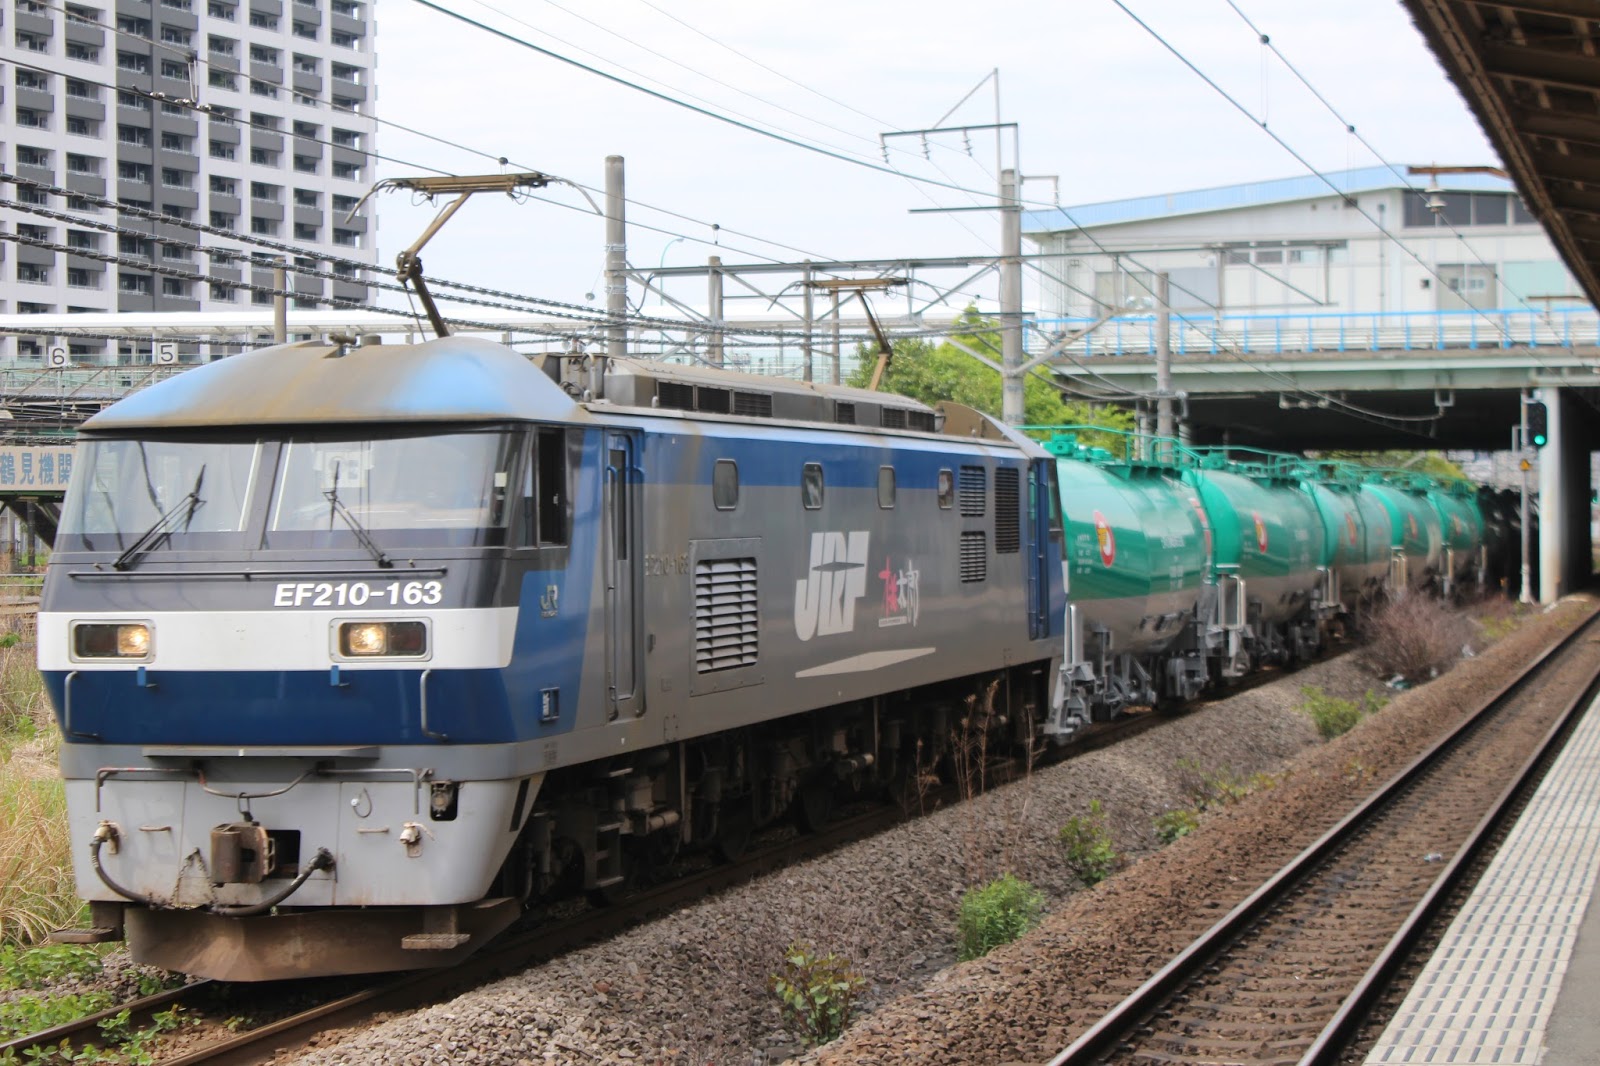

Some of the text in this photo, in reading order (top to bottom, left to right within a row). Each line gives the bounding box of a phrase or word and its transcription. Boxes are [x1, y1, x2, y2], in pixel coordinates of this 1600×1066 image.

[51, 347, 66, 365] 6
[160, 344, 174, 362] 5
[0, 452, 72, 485] 鶴見機関
[273, 581, 443, 607] EF210-163
[540, 584, 559, 610] JR
